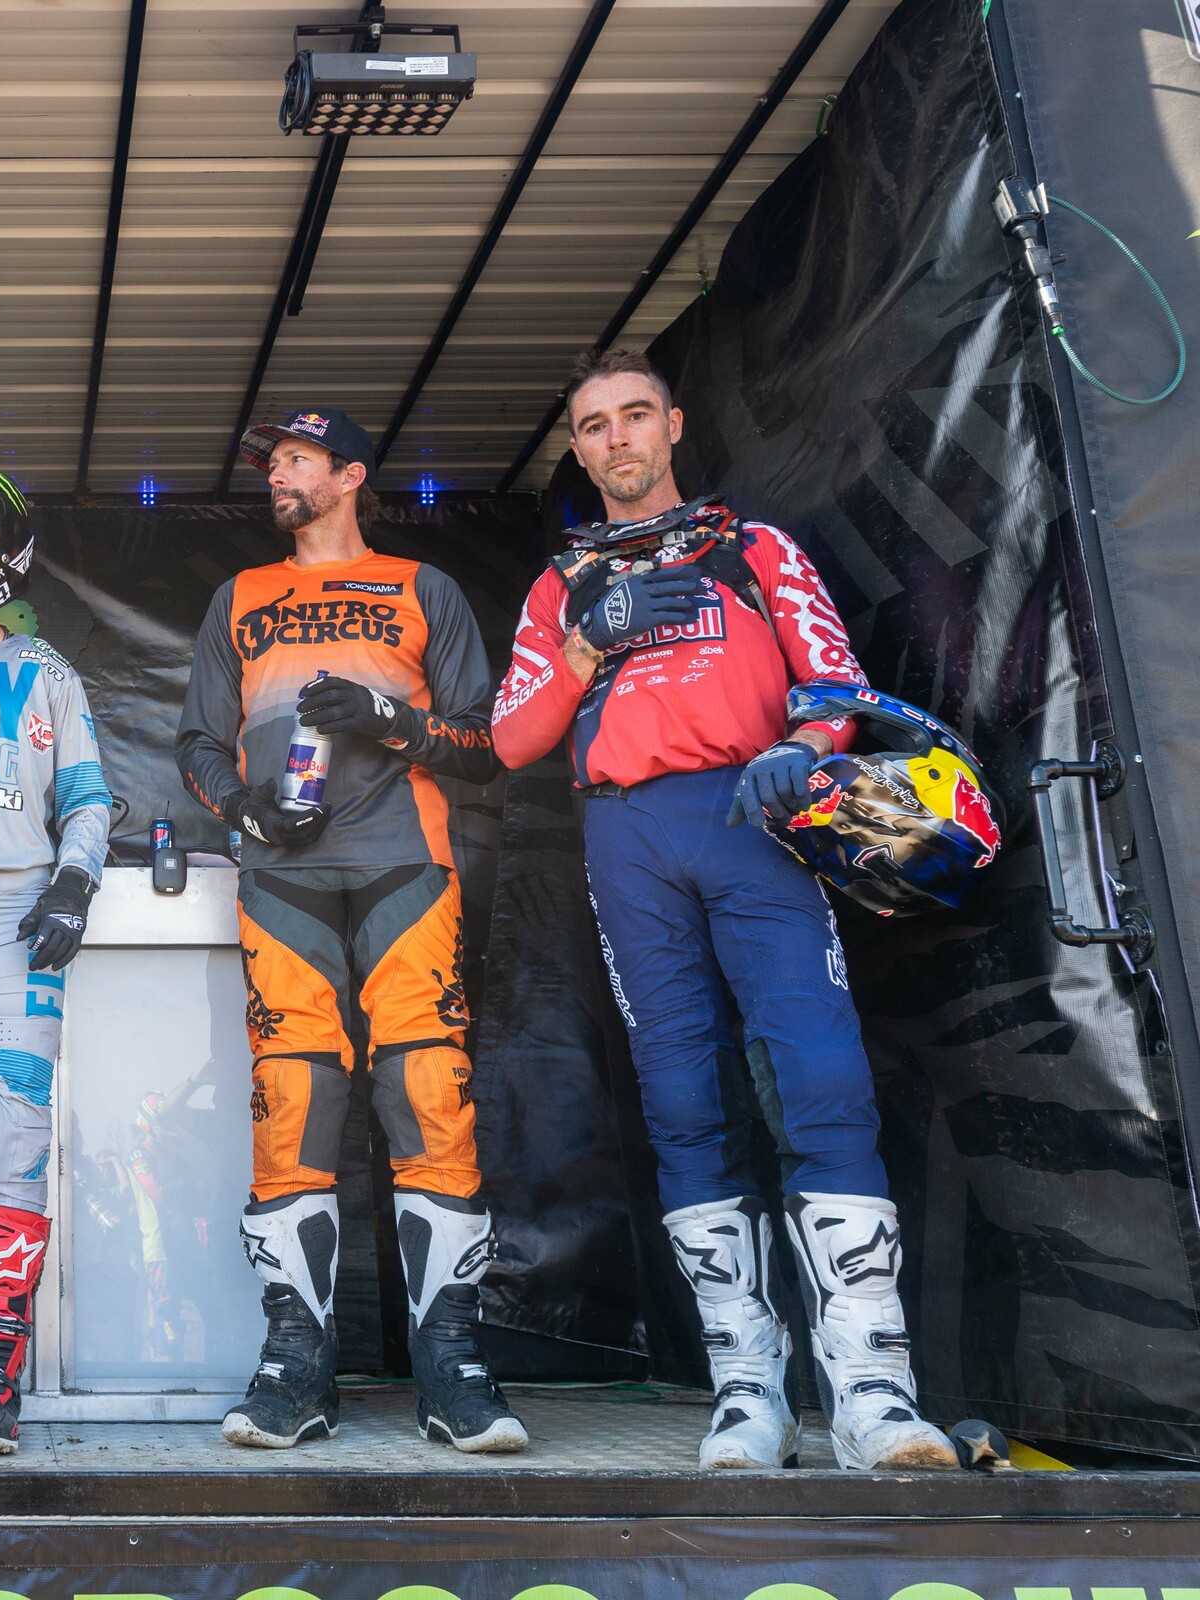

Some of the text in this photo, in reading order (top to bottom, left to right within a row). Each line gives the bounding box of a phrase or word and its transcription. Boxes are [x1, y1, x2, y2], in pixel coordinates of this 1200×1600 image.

[306, 424, 327, 437] Bull
[345, 582, 397, 593] YOKOHAMA
[280, 600, 397, 624] NITRO
[276, 619, 404, 648] CIRCUS
[633, 649, 674, 662] METHOD
[491, 664, 554, 726] GASGAS
[426, 716, 491, 749] CANVAS
[288, 757, 328, 773] Red Bull
